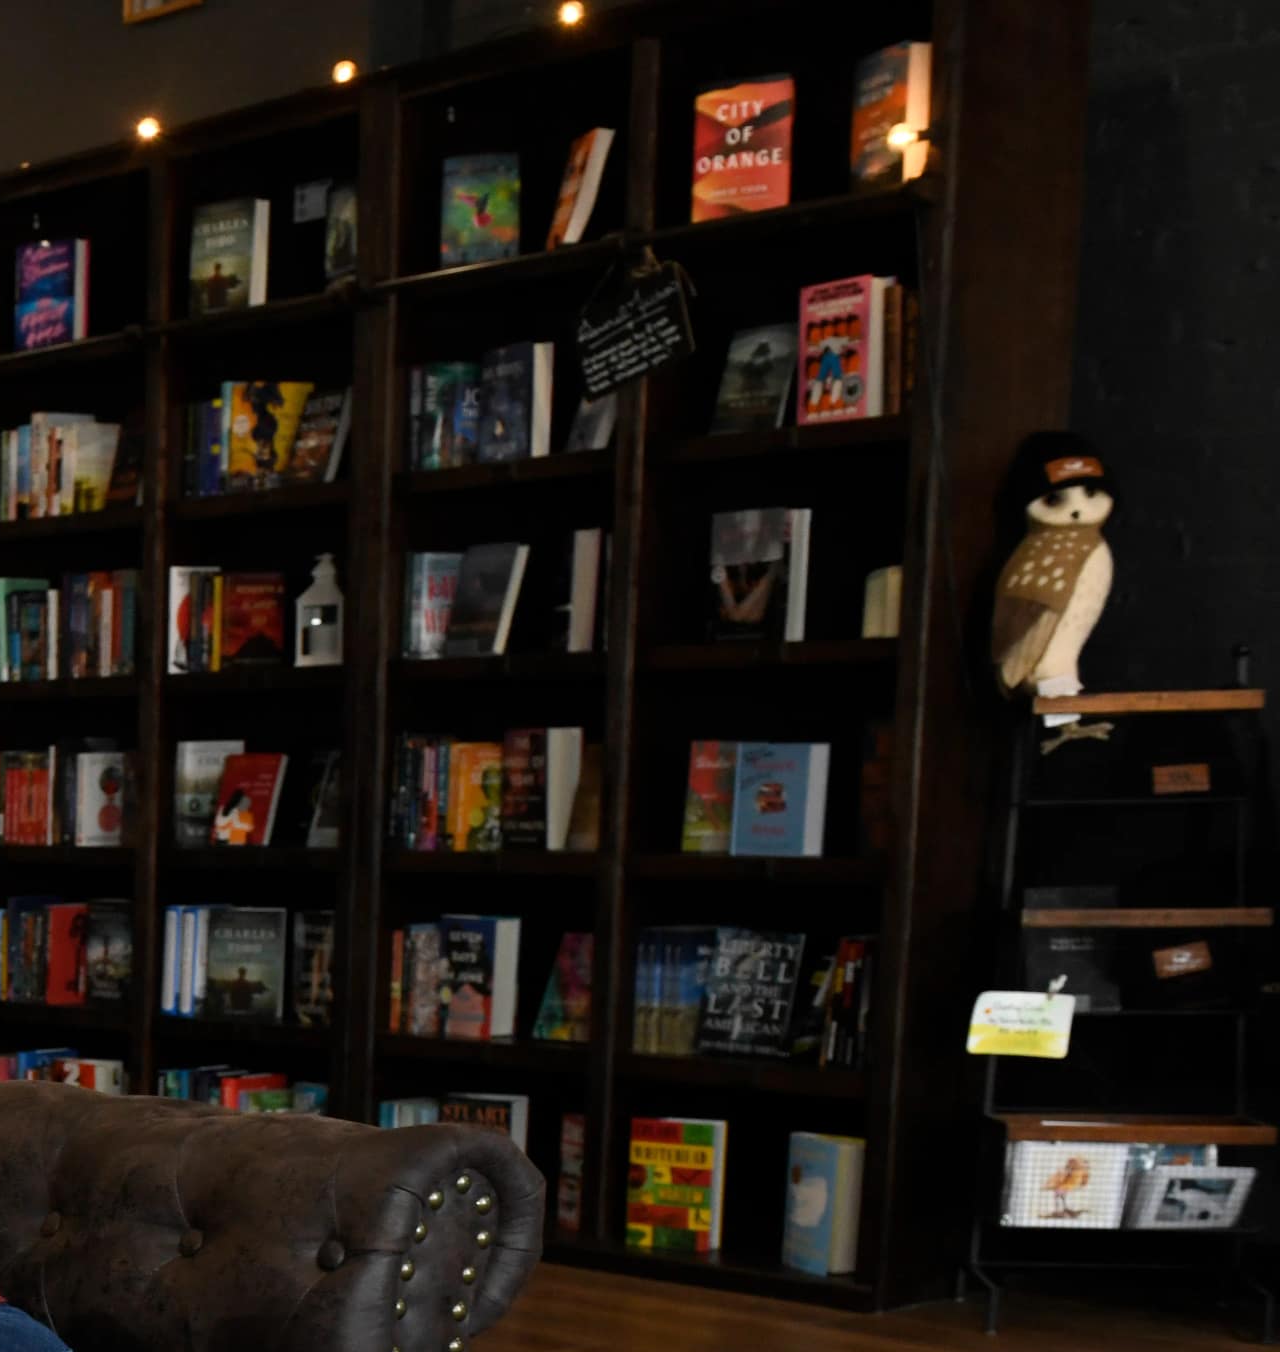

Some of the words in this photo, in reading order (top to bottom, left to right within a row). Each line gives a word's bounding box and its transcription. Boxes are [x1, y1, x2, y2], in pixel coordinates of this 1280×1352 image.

[715, 100, 765, 123] CITY
[725, 125, 756, 147] OF
[695, 147, 784, 175] ORANGE
[213, 928, 277, 940] CHARLES
[717, 937, 796, 961] LIBERTY
[716, 955, 794, 984] BELL
[706, 992, 789, 1021] LAST
[703, 1017, 781, 1034] AMERICAN
[441, 1102, 508, 1128] STUART
